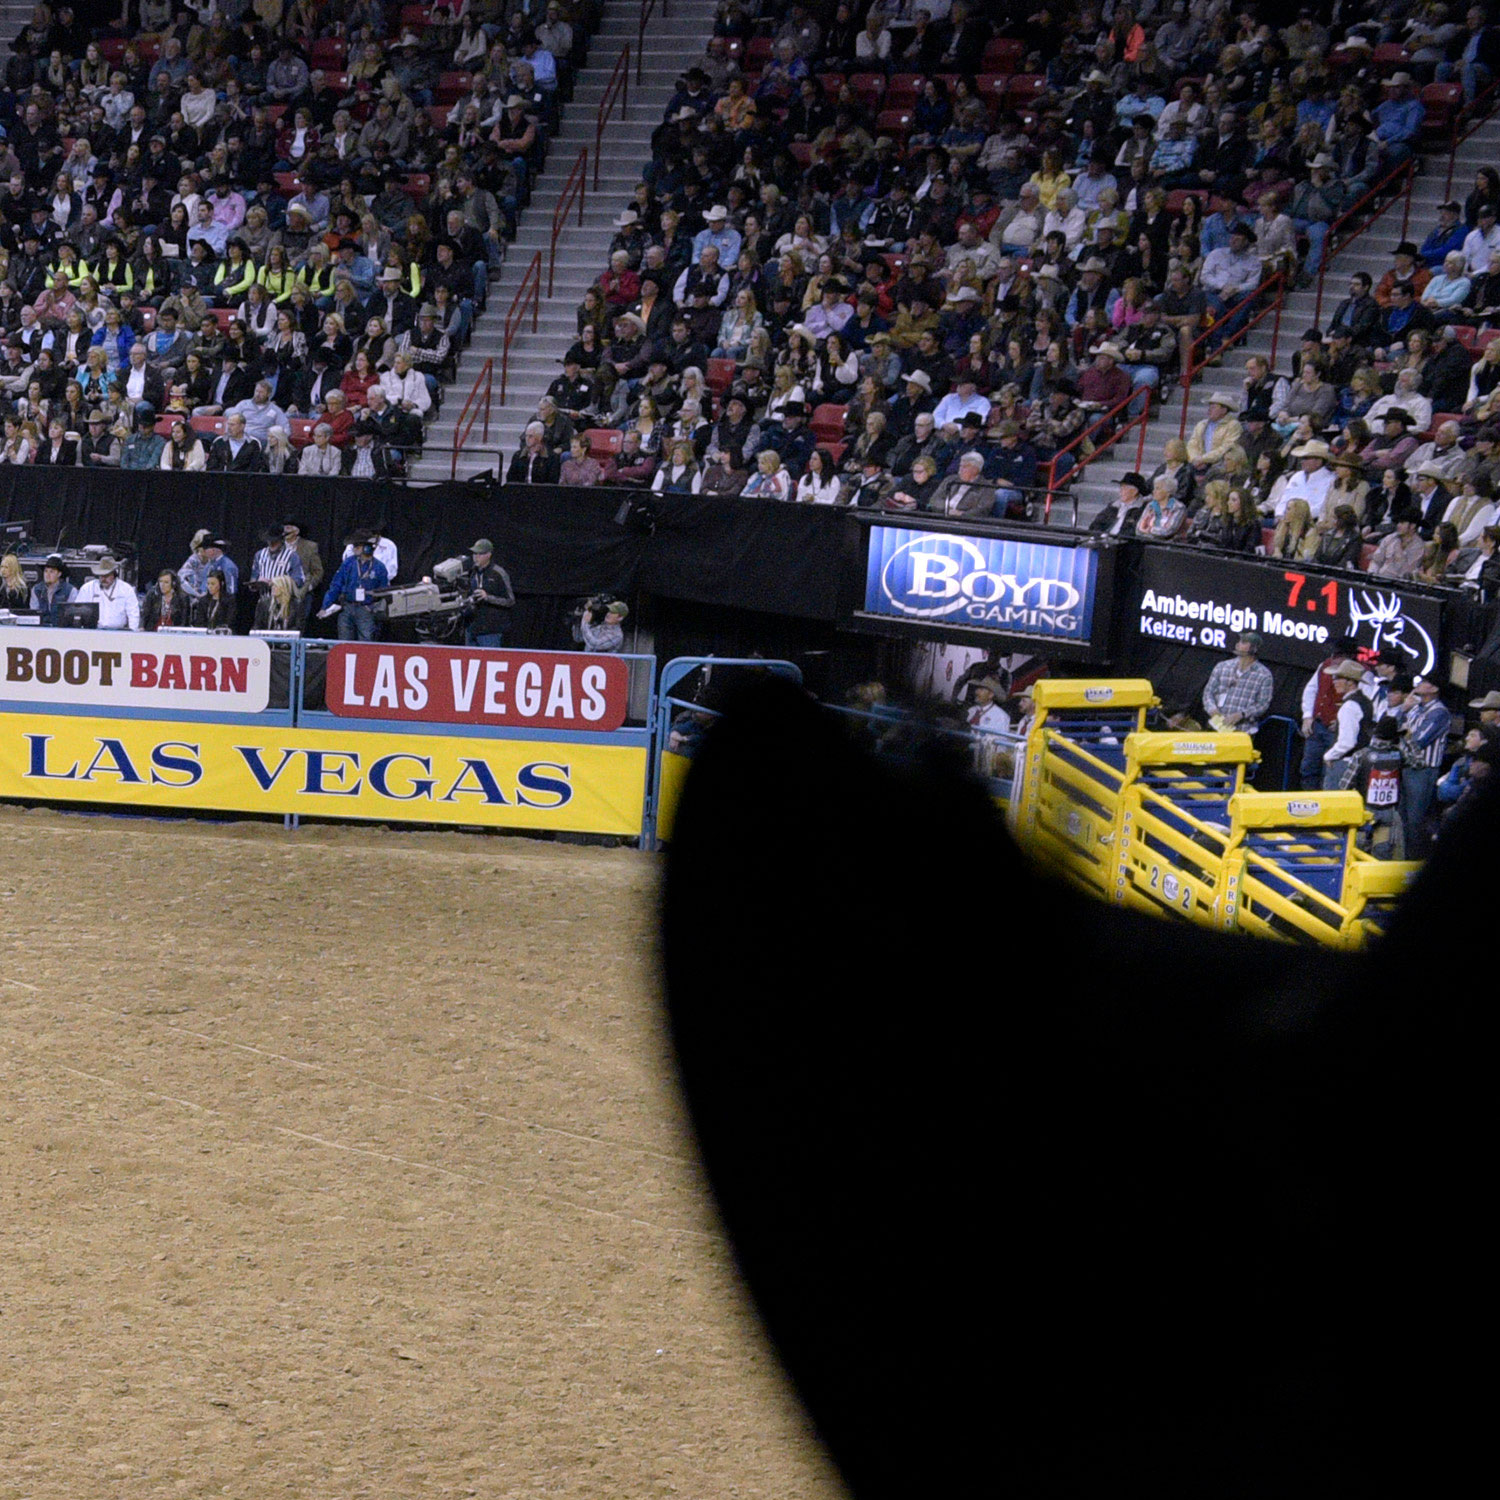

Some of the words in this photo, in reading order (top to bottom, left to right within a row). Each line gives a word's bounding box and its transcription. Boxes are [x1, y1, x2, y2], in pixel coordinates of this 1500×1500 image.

[1140, 589, 1256, 632] Amberleigh
[1263, 611, 1328, 643] Moore
[1284, 572, 1338, 616] 7.1
[966, 603, 1077, 631] GAMING
[1140, 616, 1197, 646] Keizer,
[1200, 627, 1226, 648] OR
[5, 646, 121, 687] BOOT
[130, 653, 250, 694] BARN
[344, 653, 428, 711] LAS
[451, 658, 606, 722] VEGAS
[22, 732, 201, 788] LAS
[234, 745, 573, 809] VEGAS
[1373, 790, 1393, 802] 106
[1151, 866, 1158, 888] 2
[1182, 887, 1190, 910] 2
